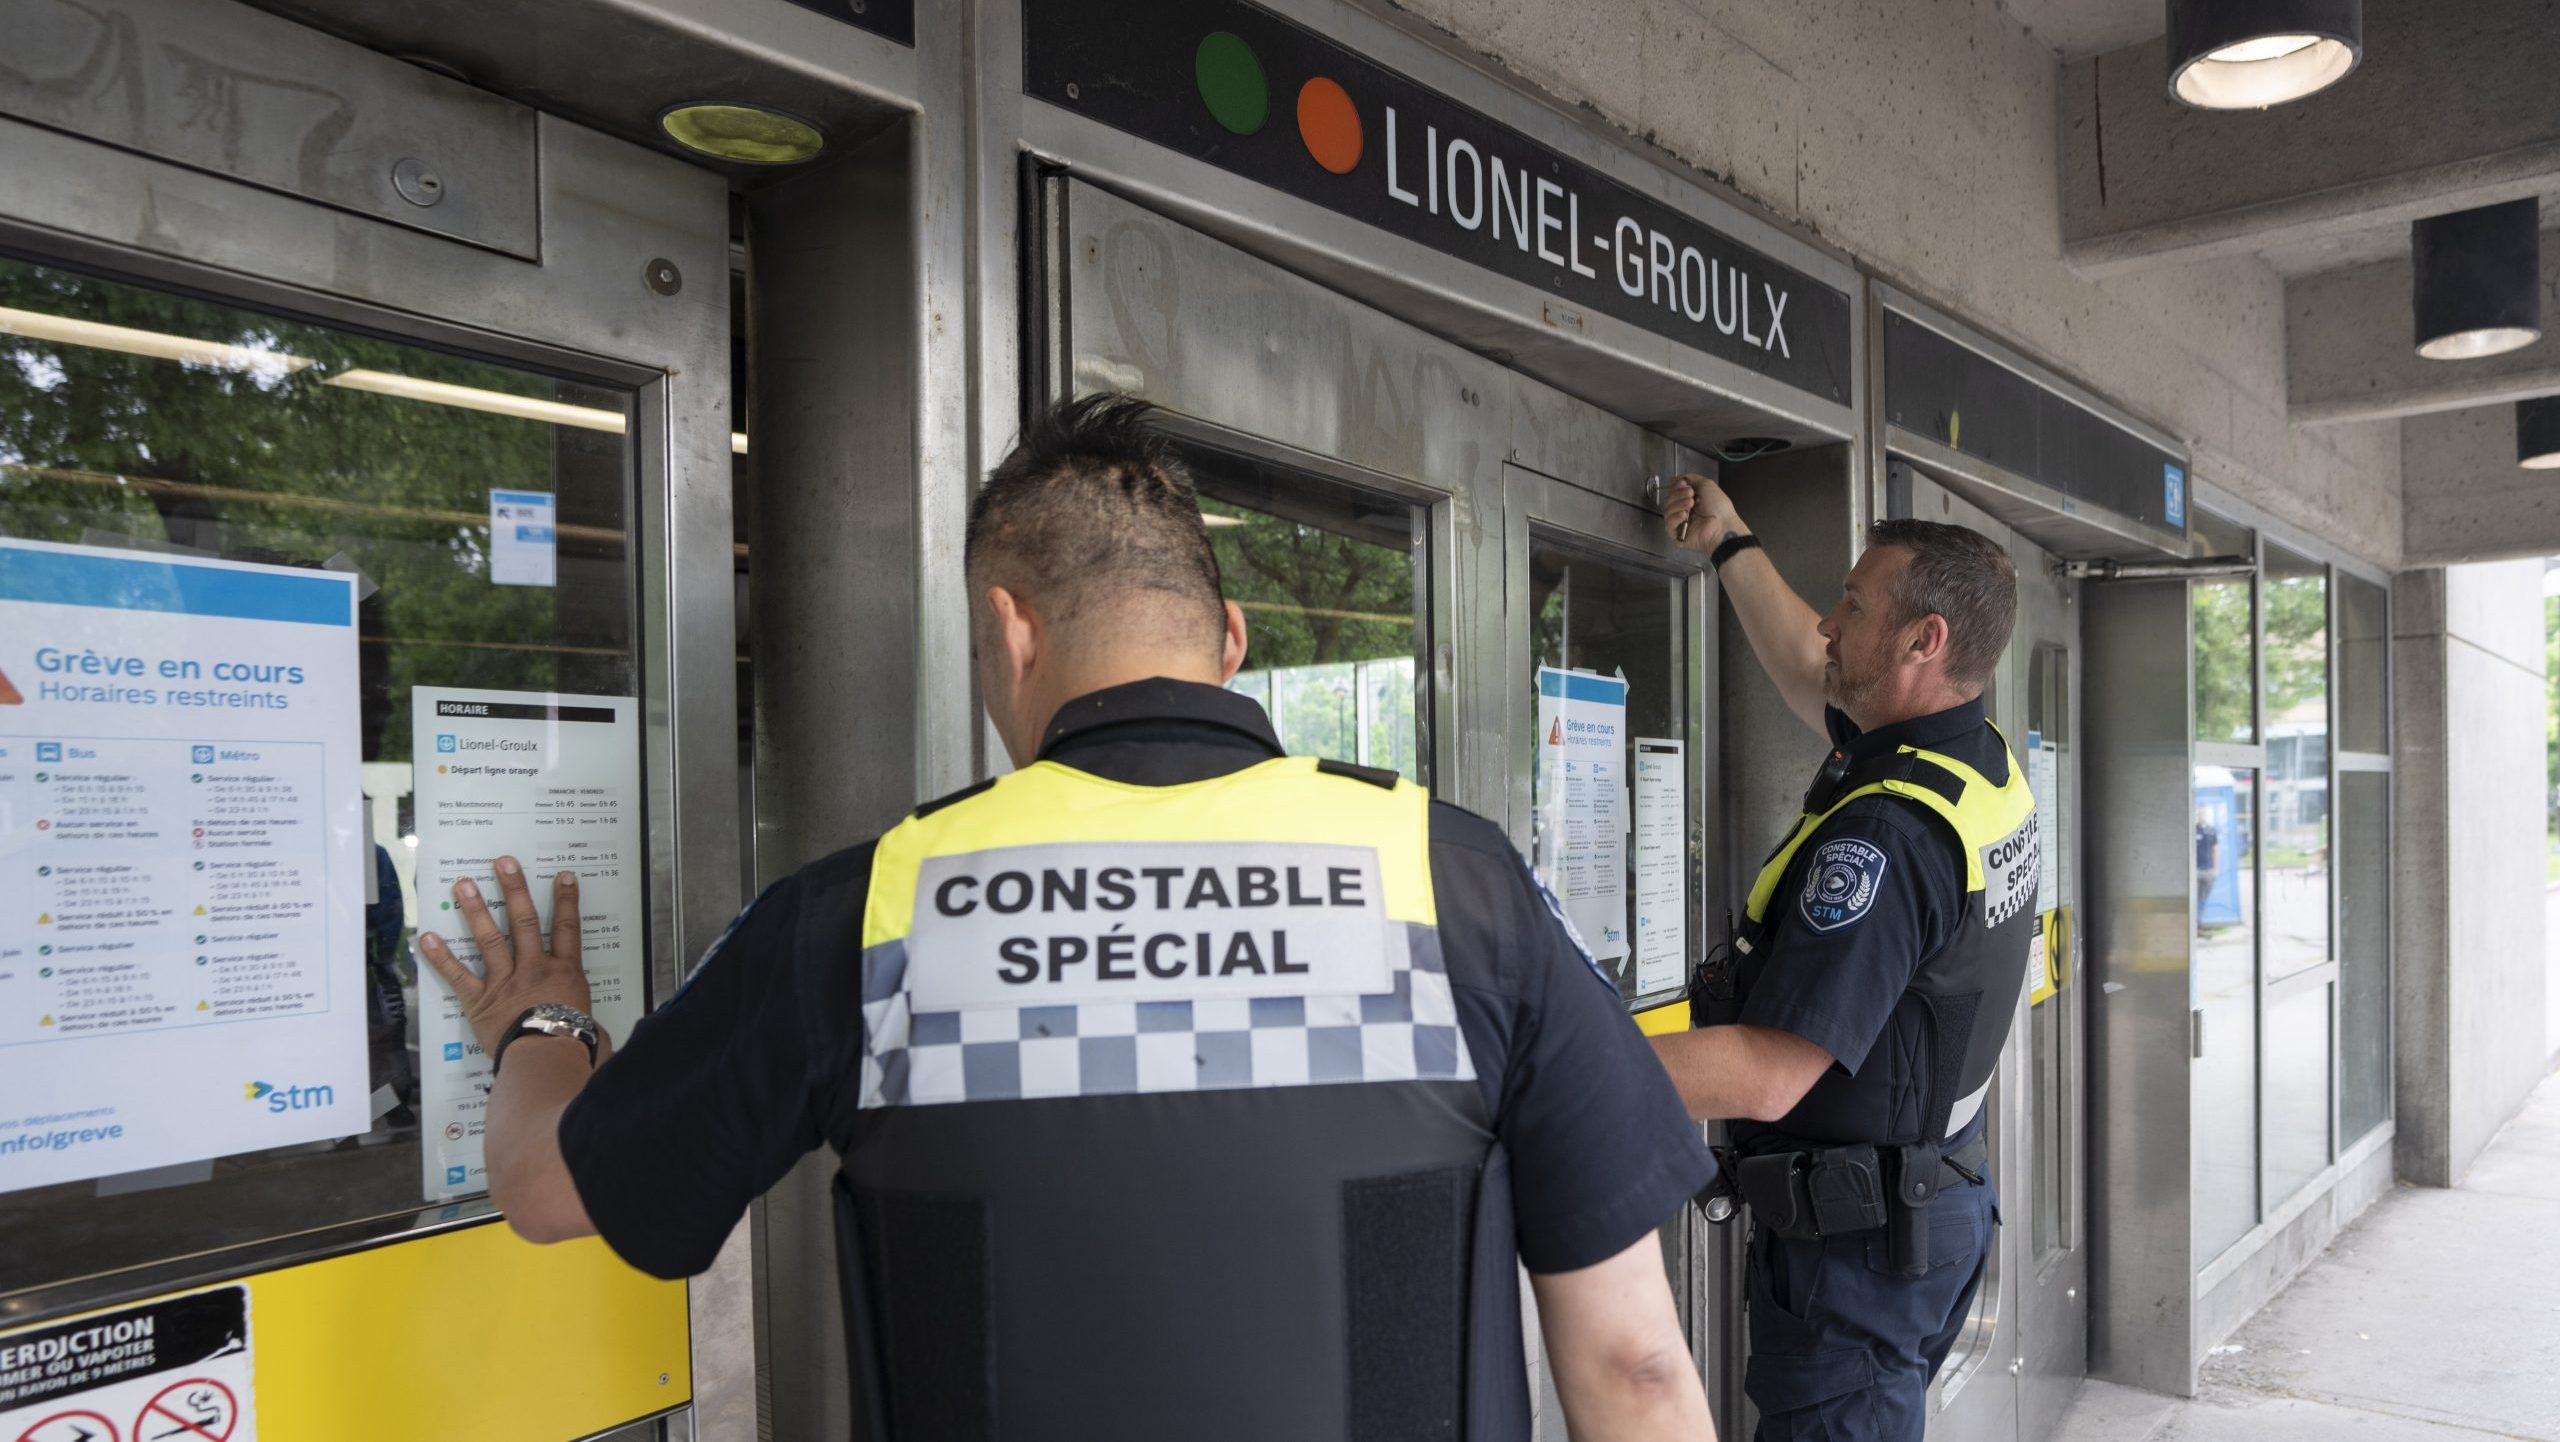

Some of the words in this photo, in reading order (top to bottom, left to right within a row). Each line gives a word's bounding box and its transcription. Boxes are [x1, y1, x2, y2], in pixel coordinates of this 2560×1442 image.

[1385, 106, 1791, 360] LIONEL-GROULX
[35, 648, 145, 677] Grève
[159, 659, 201, 679] en
[213, 662, 304, 685] cours
[40, 681, 157, 704] Horaires
[166, 687, 288, 709] restreints
[440, 703, 489, 715] HORAIRE
[1566, 719, 1585, 732] Grève
[1587, 722, 1595, 733] en
[1597, 724, 1615, 735] cours
[68, 748, 97, 758] Bus
[459, 738, 538, 751] Lionel-Groulx
[451, 764, 482, 775] Départ
[484, 765, 506, 776] ligne
[508, 767, 539, 777] orange
[1821, 843, 1878, 863] CONSTABLE
[1825, 851, 1864, 868] SPÉCIAL
[935, 866, 1366, 917] CONSTABLE
[1811, 905, 1842, 920] STM
[1607, 930, 1620, 942] stm
[997, 923, 1309, 985] SPÉCIAL
[268, 1084, 334, 1113] stm
[46, 1358, 74, 1376] OU
[77, 1338, 155, 1368] VAPOTER
[18, 1375, 68, 1397] RAYON
[70, 1369, 89, 1385] DE
[90, 1367, 102, 1380] 9
